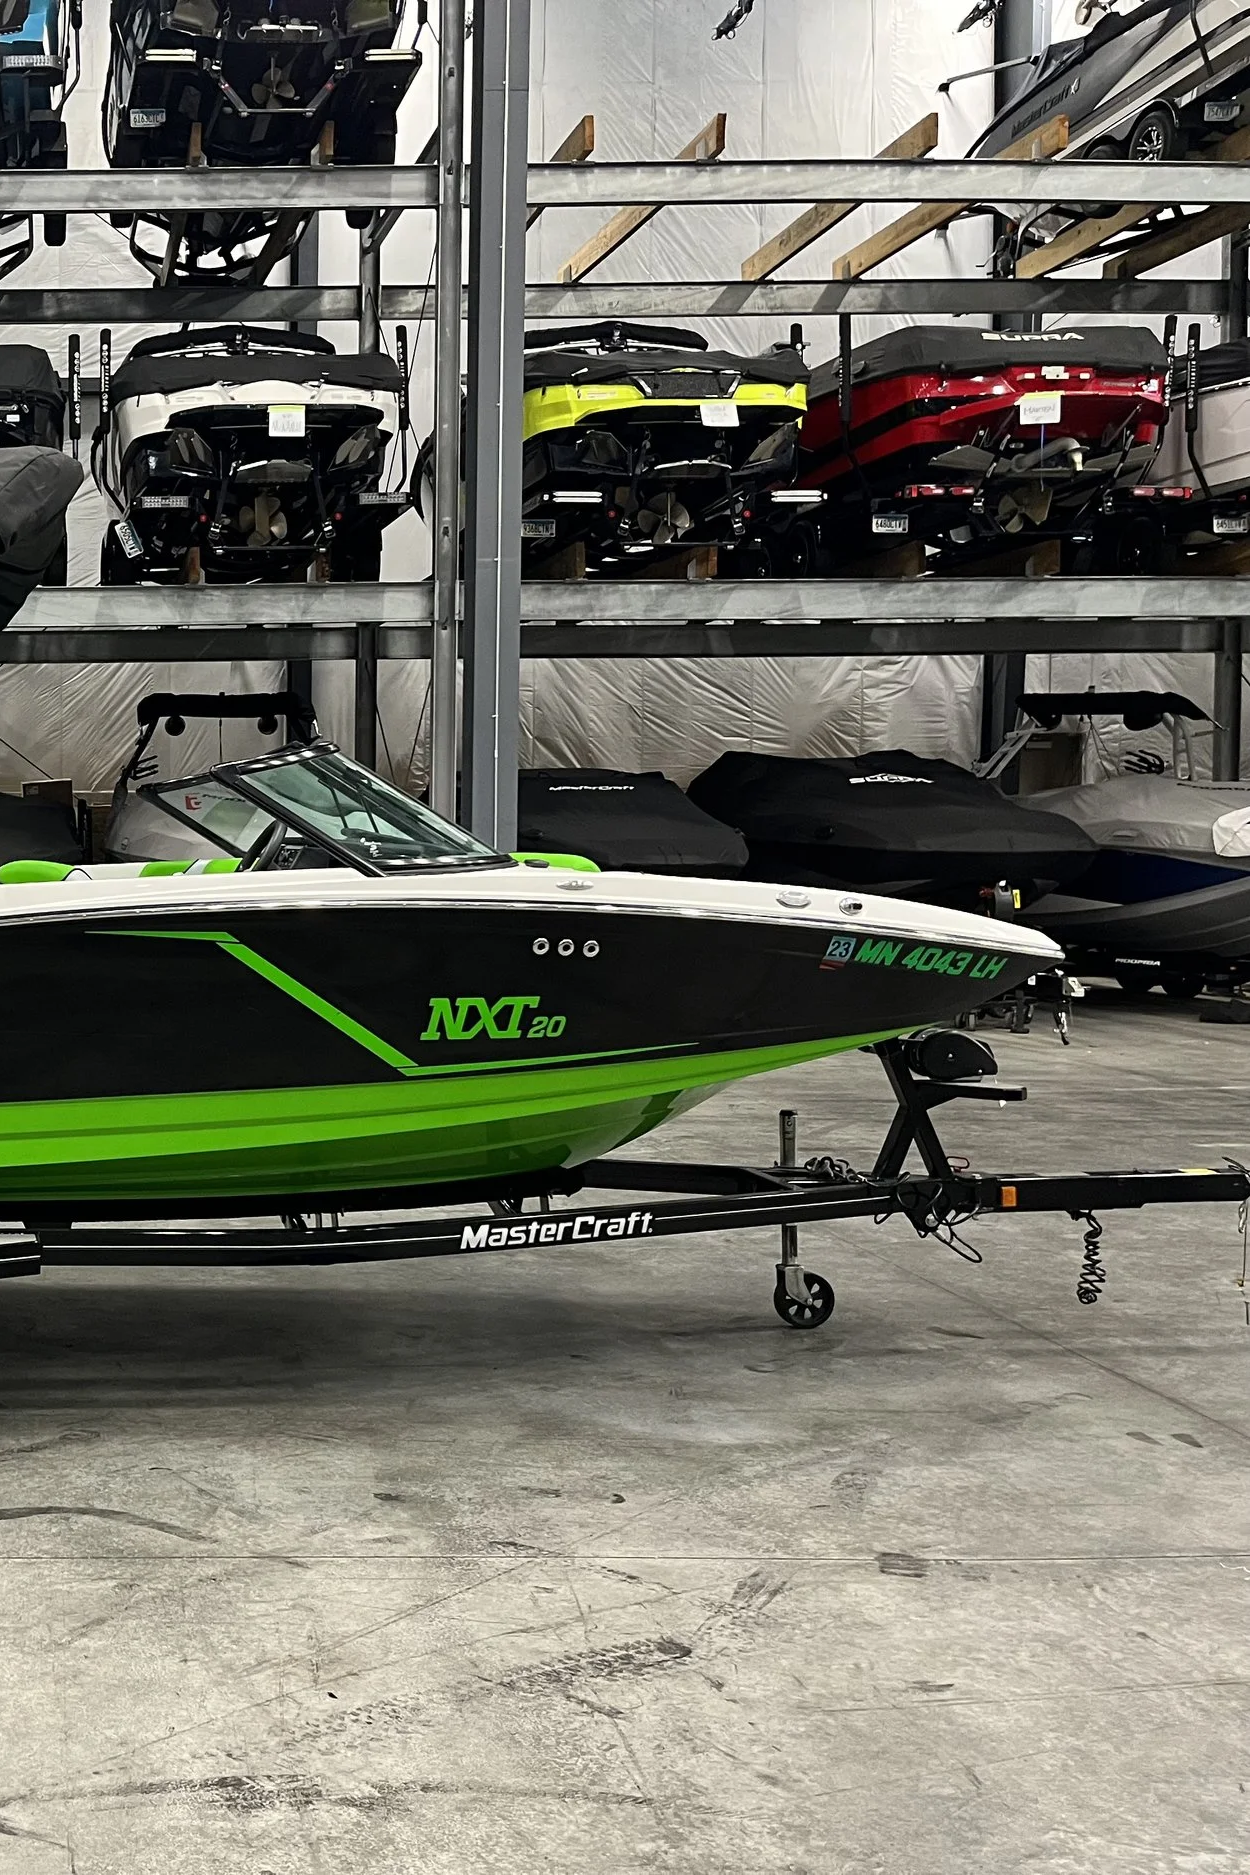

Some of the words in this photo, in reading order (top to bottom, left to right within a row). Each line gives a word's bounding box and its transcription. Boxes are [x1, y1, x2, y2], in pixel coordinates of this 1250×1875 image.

[981, 332, 1085, 342] SUPRA
[827, 940, 852, 958] 23
[853, 938, 904, 966] MN
[901, 945, 974, 976] 4043
[968, 954, 1009, 980] LH
[419, 995, 541, 1041] NXT
[526, 1015, 567, 1039] 20
[460, 1211, 654, 1250] MasterCraft
